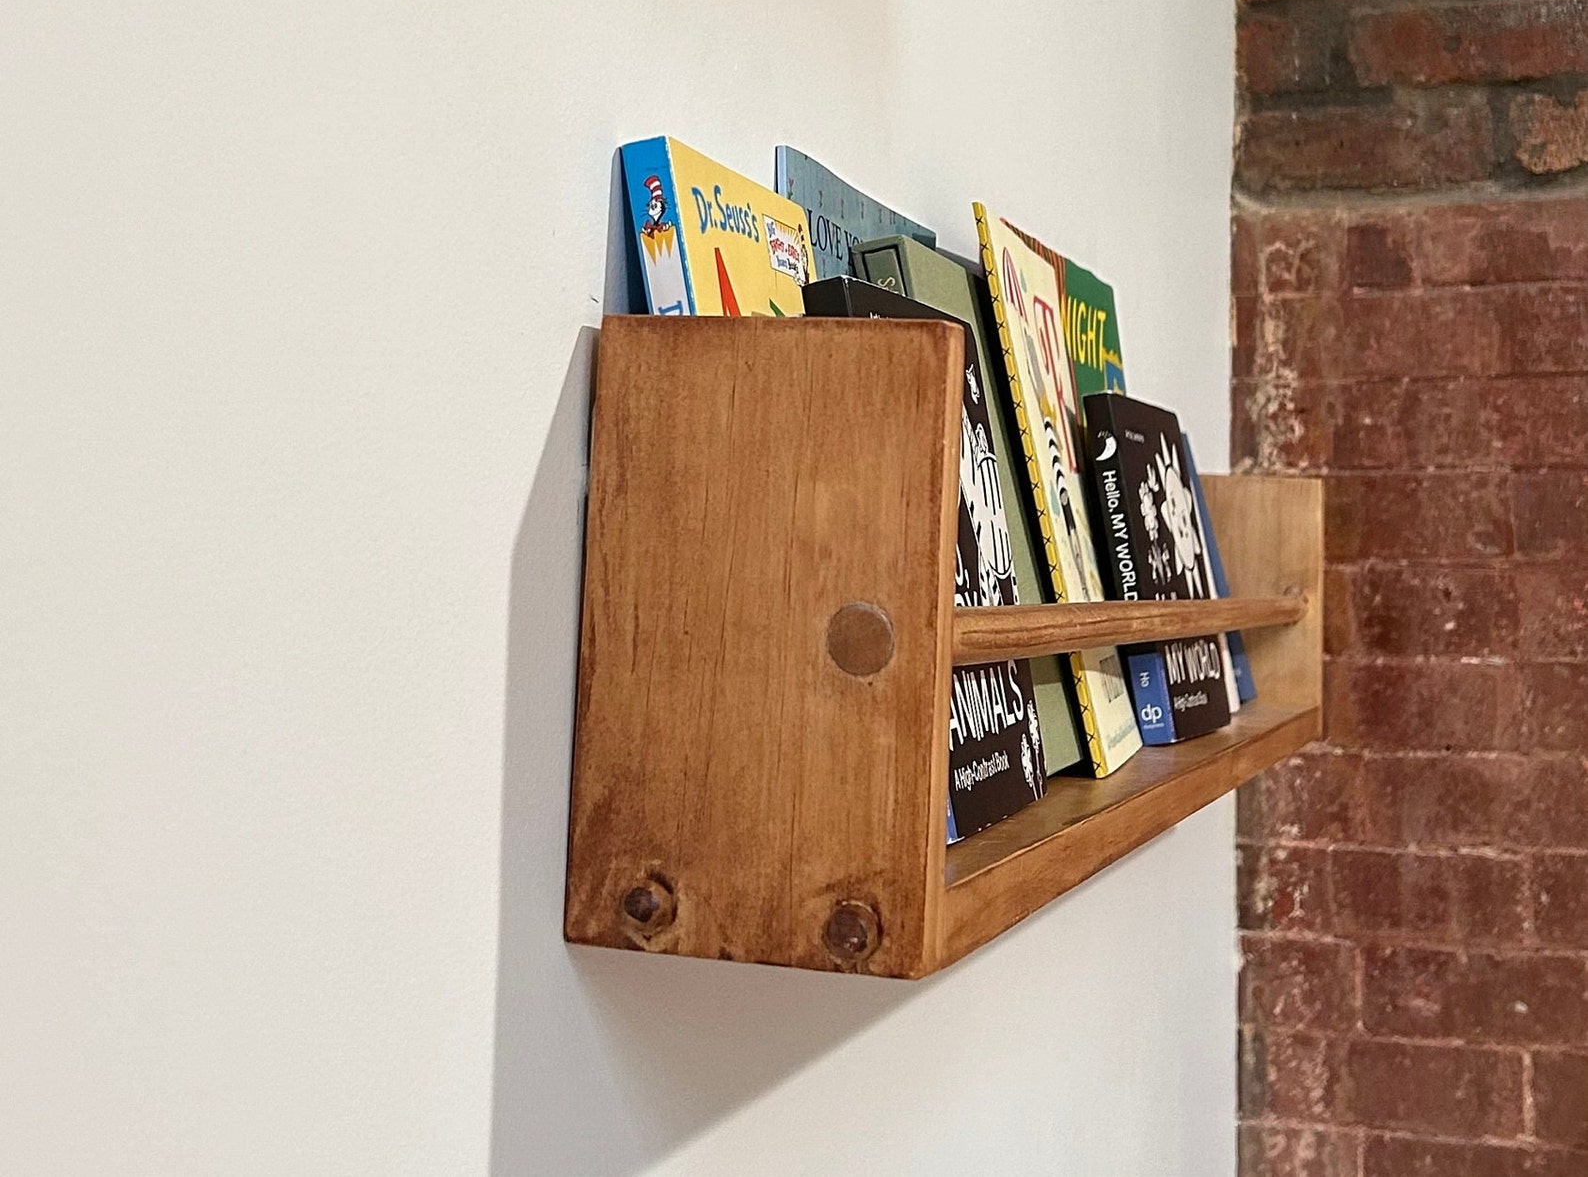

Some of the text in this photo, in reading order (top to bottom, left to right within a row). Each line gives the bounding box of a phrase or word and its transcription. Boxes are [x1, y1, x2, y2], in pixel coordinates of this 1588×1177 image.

[691, 184, 760, 243] Dr. Seuss's
[807, 209, 844, 261] LOVE
[1102, 470, 1121, 513] Hello,
[1111, 512, 1129, 540] MY
[948, 659, 1026, 752] ANIMALS
[1141, 703, 1163, 724] dp
